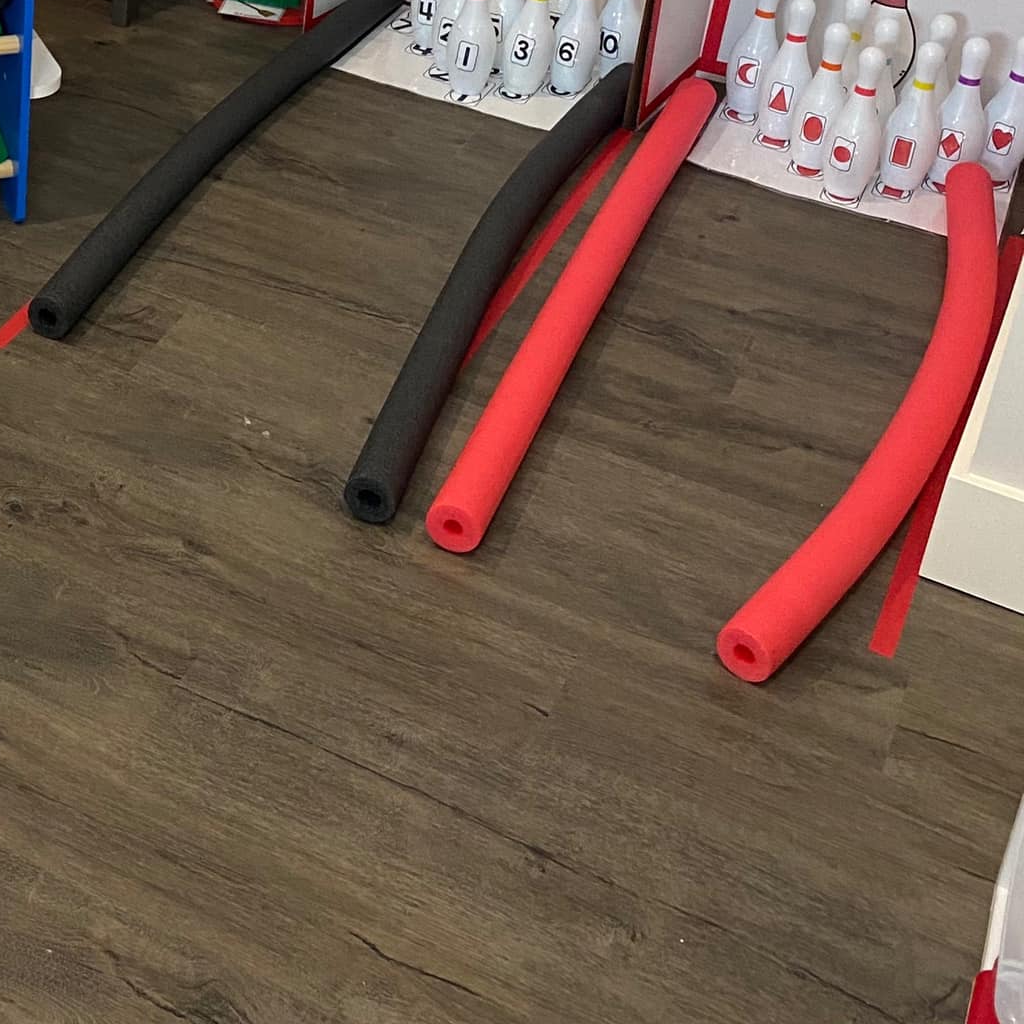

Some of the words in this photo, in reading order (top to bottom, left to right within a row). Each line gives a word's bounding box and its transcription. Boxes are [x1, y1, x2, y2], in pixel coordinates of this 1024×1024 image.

[419, 1, 433, 21] 4
[513, 39, 529, 61] 3
[559, 42, 575, 62] 6
[600, 31, 618, 54] 10
[462, 47, 471, 67] 1
